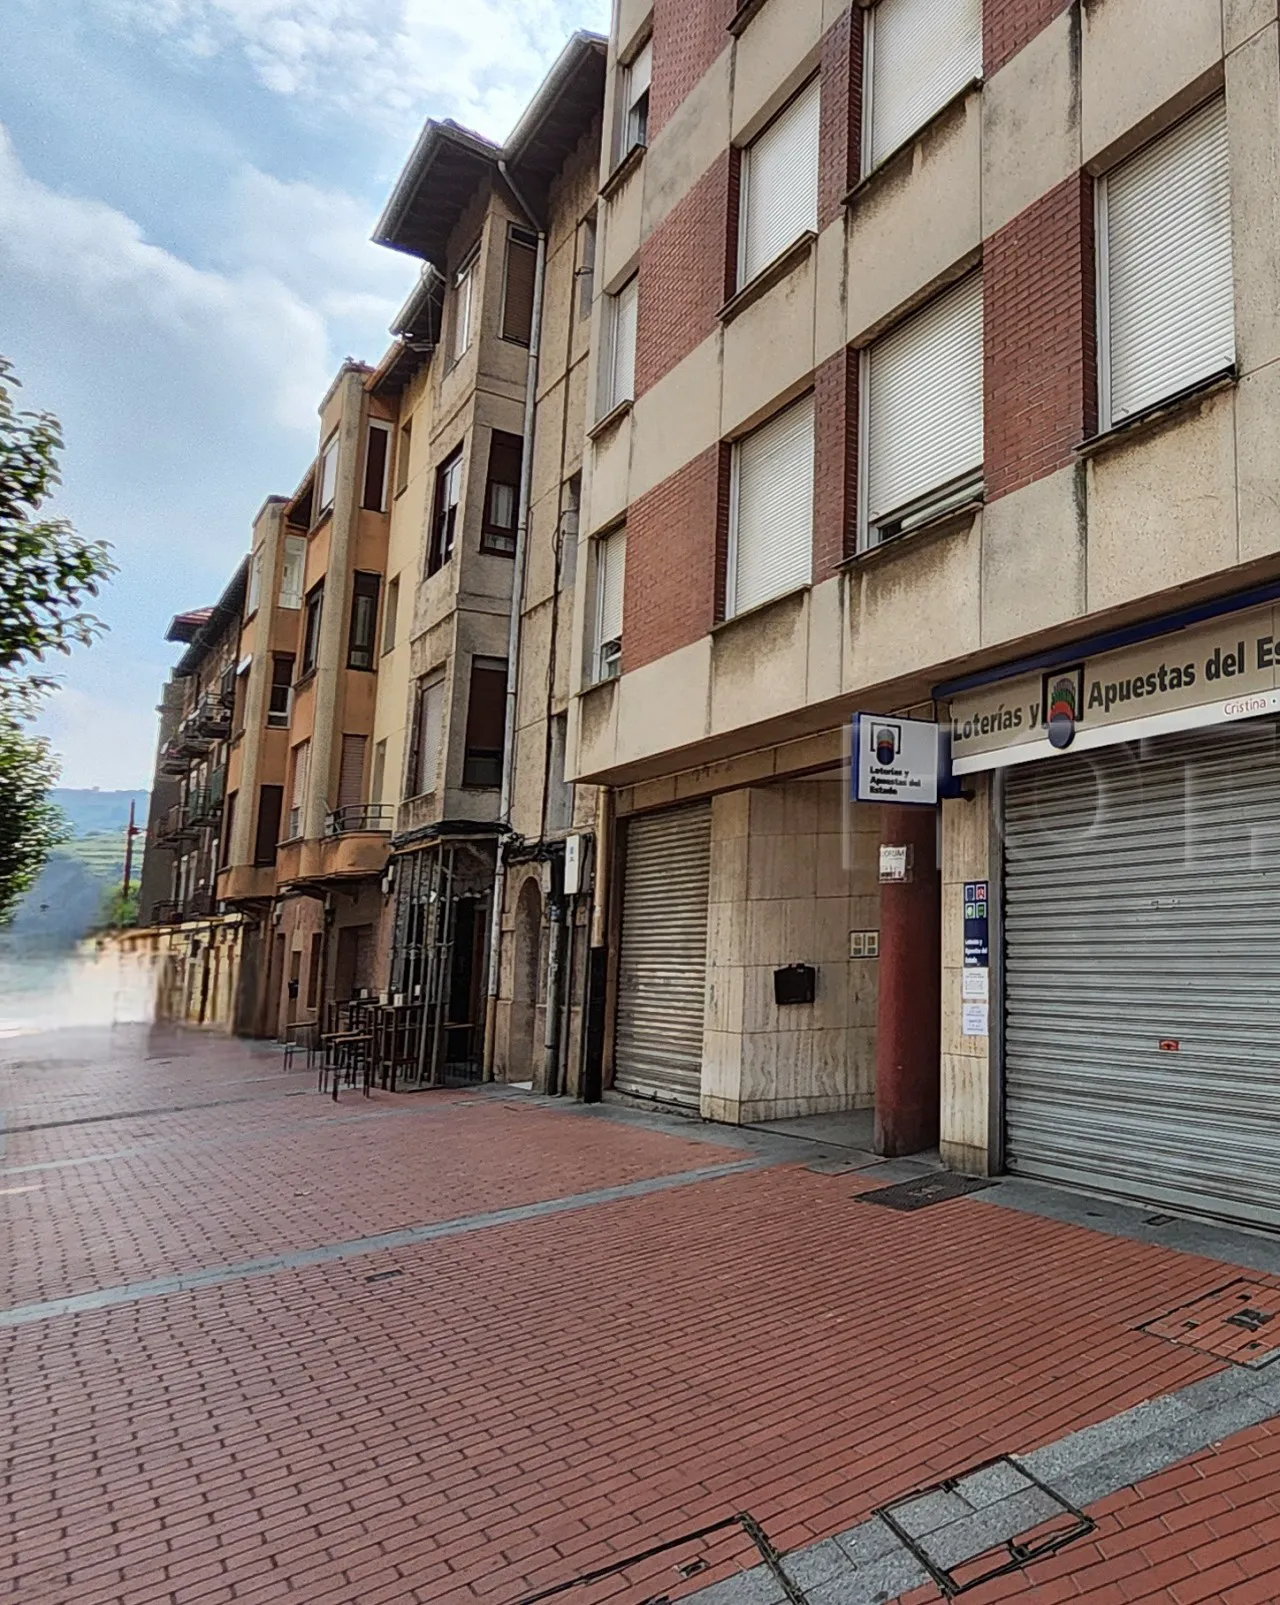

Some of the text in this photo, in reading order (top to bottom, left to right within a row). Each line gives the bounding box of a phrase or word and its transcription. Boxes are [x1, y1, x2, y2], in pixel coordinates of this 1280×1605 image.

[953, 703, 1022, 742] Loterías
[1029, 702, 1041, 730] y
[1087, 661, 1196, 713] Apuestas
[1204, 641, 1246, 681] del
[1223, 698, 1267, 715] Cristina
